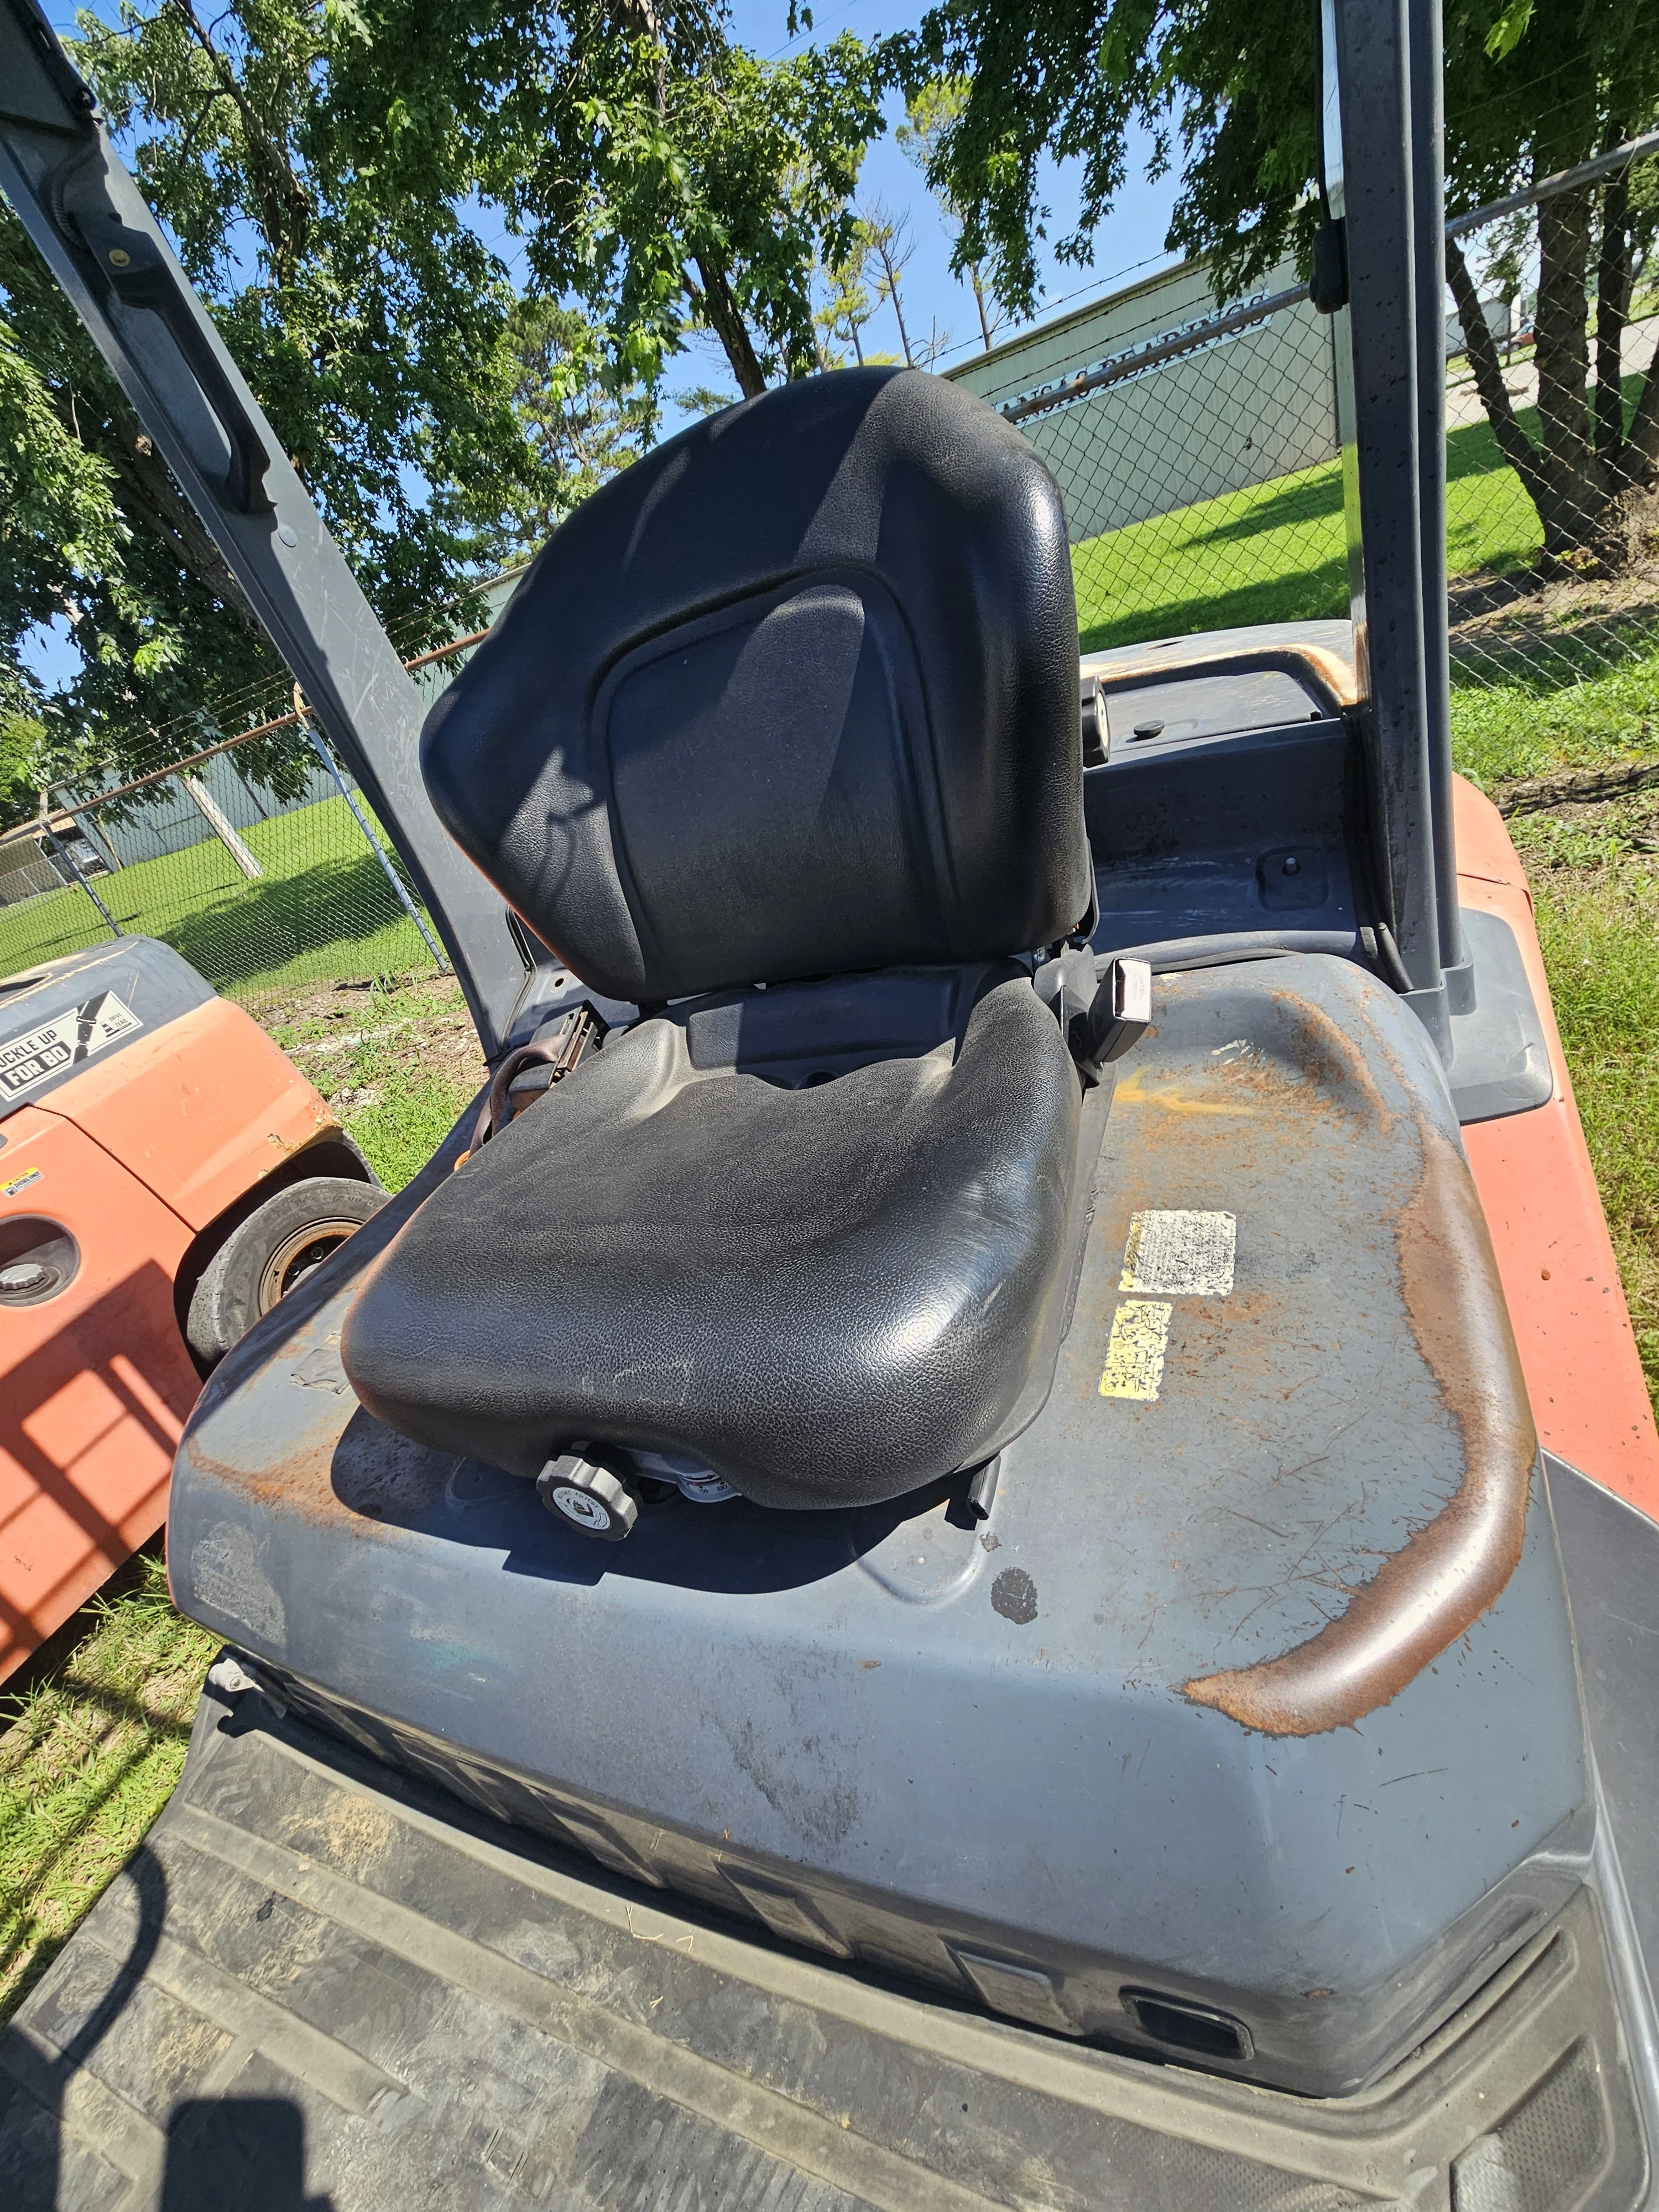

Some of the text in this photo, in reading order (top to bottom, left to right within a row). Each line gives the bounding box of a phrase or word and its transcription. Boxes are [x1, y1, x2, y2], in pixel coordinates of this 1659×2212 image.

[109, 1013, 122, 1021] DRIVE
[114, 1019, 128, 1027] ZERO
[38, 1030, 57, 1045] UP
[4, 1046, 69, 1086] FOR BO
[14, 1178, 30, 1187] DIESEL
